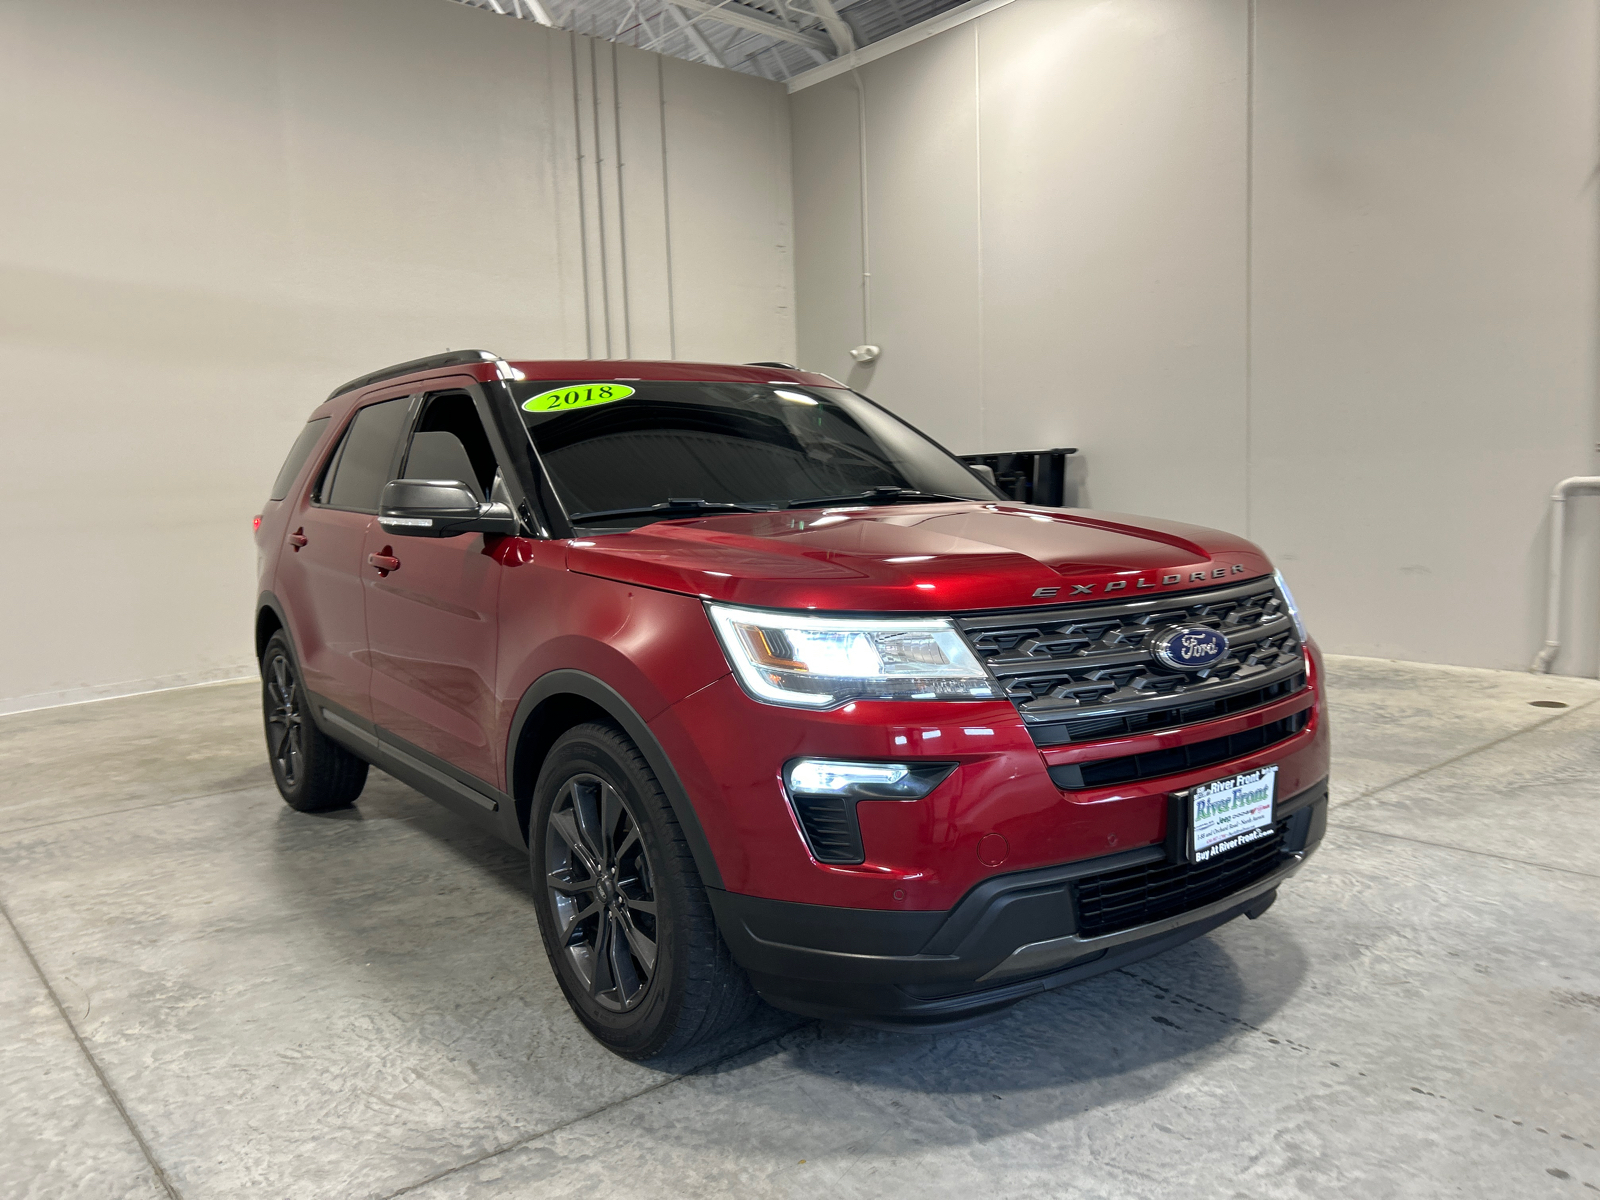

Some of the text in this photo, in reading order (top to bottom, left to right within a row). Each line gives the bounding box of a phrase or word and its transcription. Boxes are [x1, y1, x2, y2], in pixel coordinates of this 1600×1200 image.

[546, 385, 614, 410] 2018
[1031, 563, 1245, 598] EXPLORER
[1181, 633, 1219, 660] Ford
[1211, 780, 1235, 794] River
[1236, 771, 1260, 786] Front
[1196, 797, 1231, 822] River
[1231, 784, 1269, 810] Front
[1196, 850, 1209, 862] Buy
